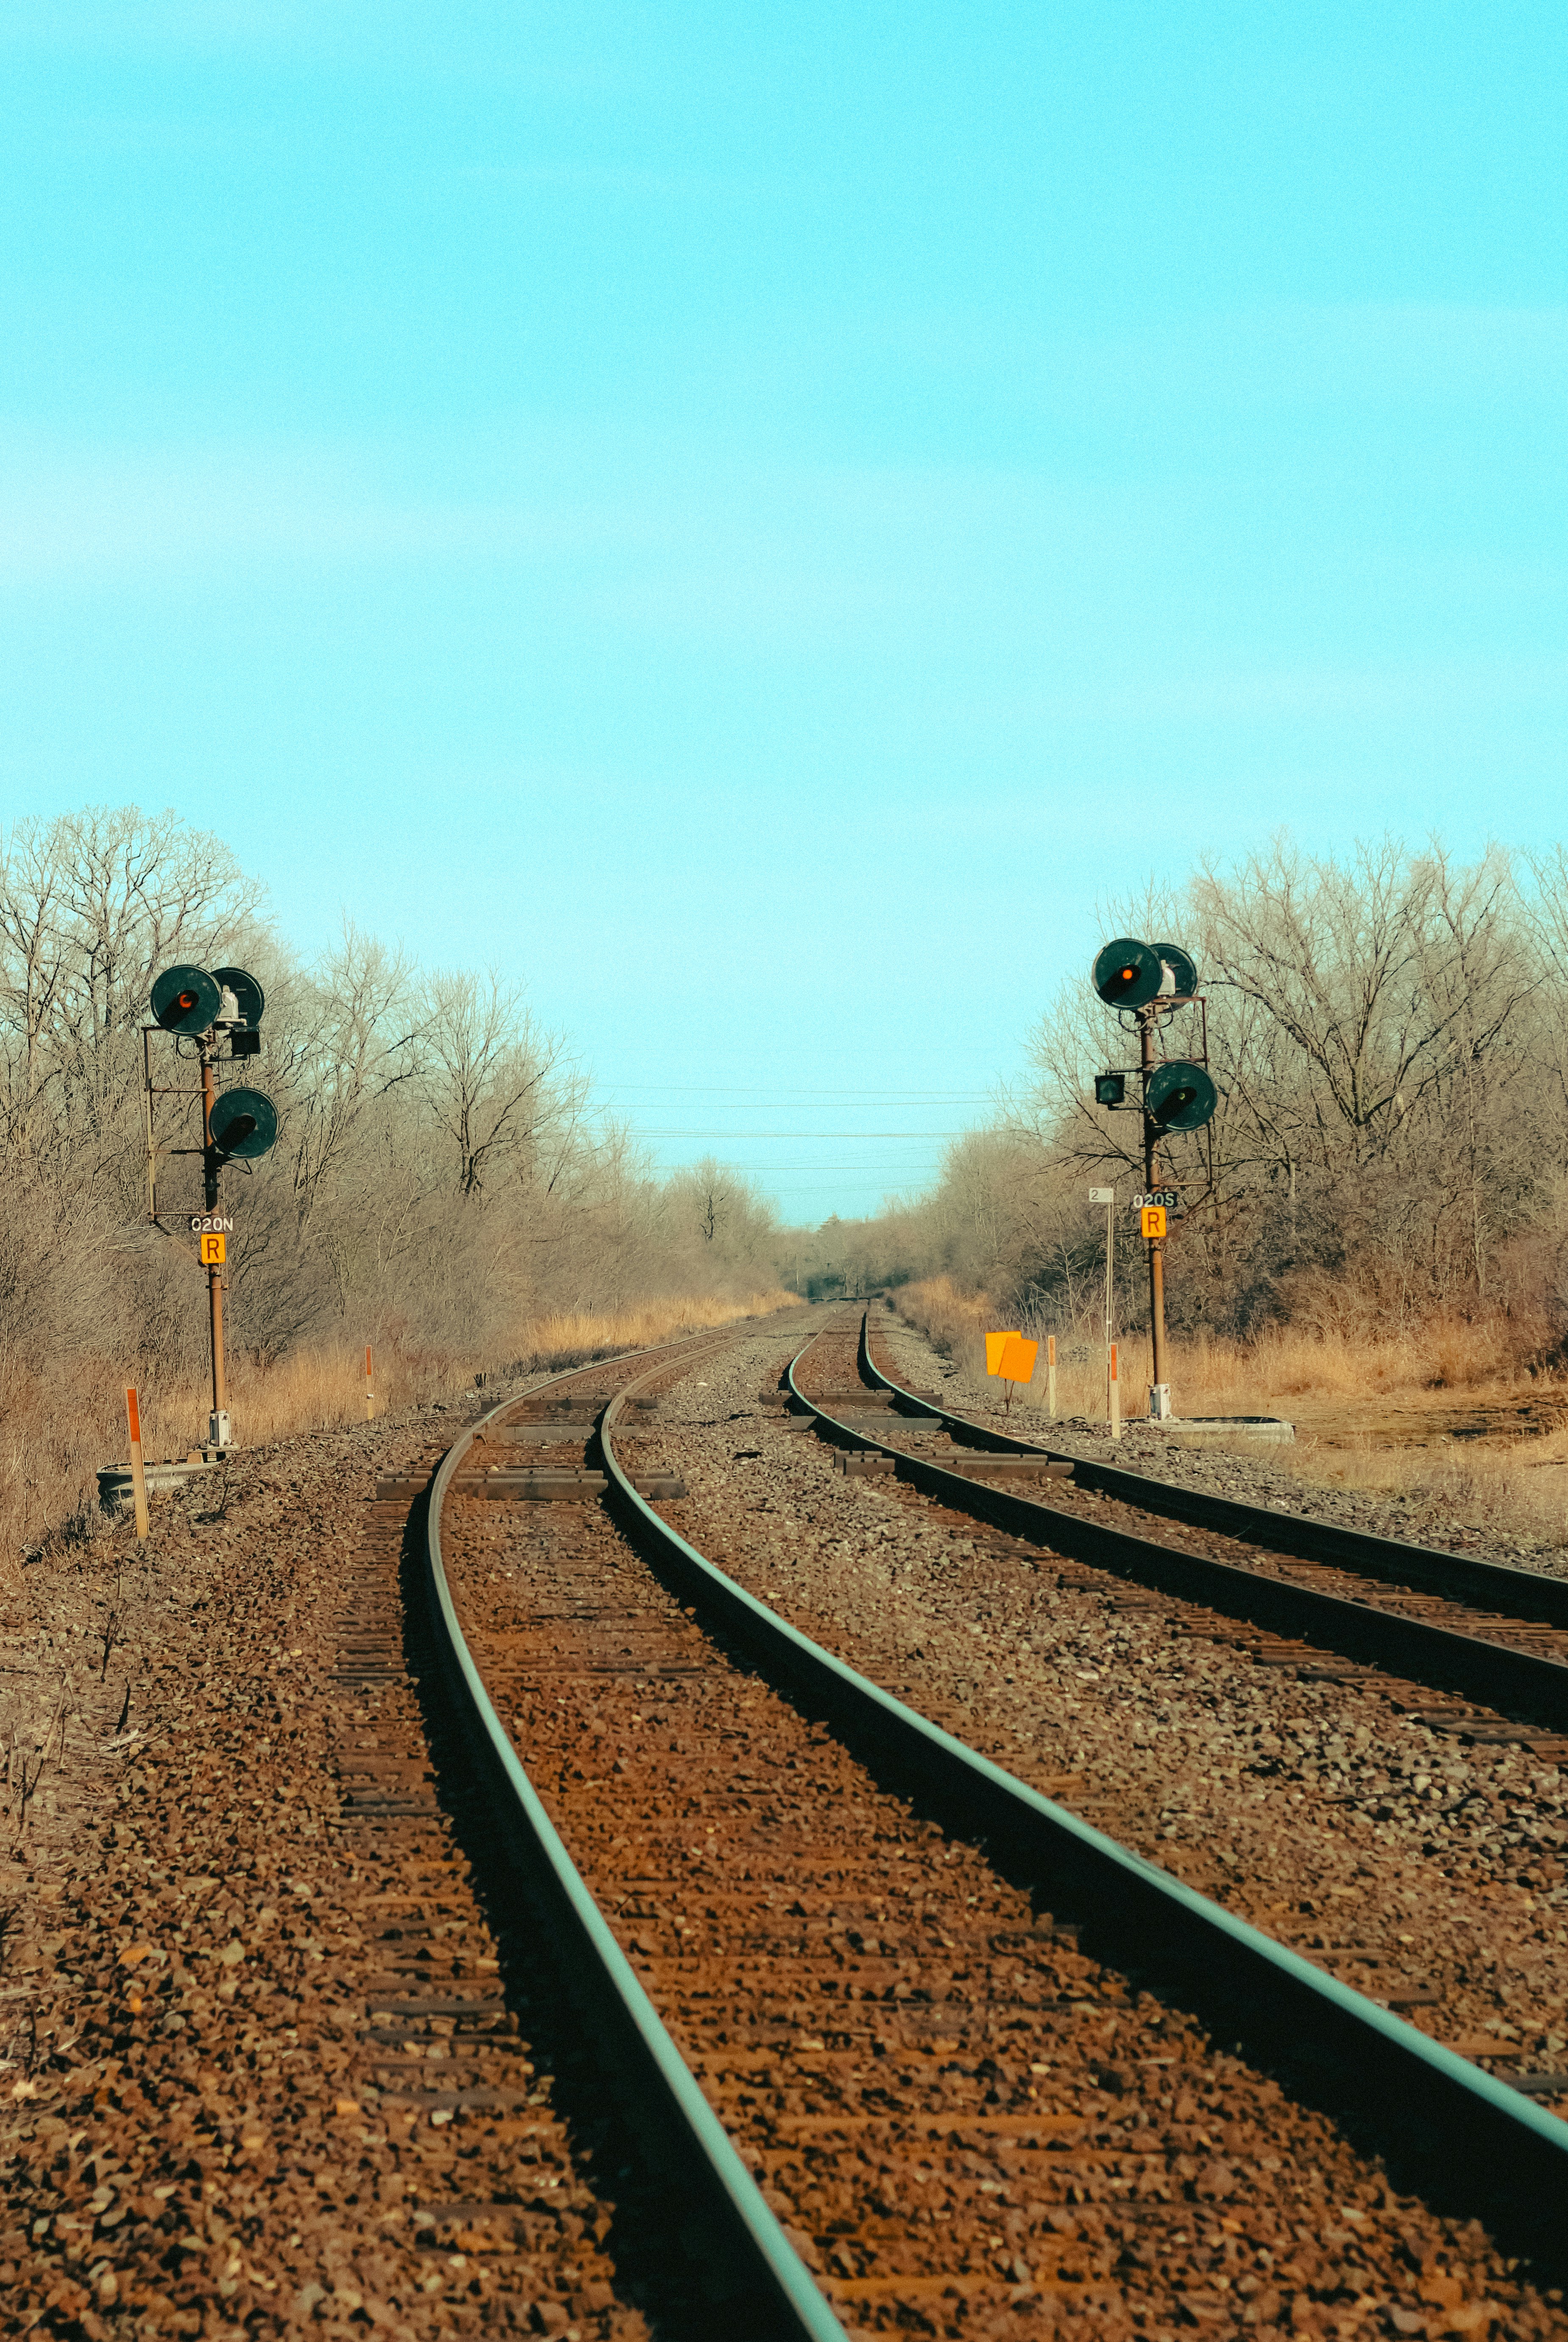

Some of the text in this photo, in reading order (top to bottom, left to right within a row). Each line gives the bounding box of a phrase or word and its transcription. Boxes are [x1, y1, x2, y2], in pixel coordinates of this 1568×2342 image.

[1091, 1189, 1099, 1200] 2
[1133, 1193, 1174, 1208] 020S
[191, 1217, 233, 1232] 020N
[1147, 1212, 1160, 1233] R
[206, 1238, 220, 1259] R
